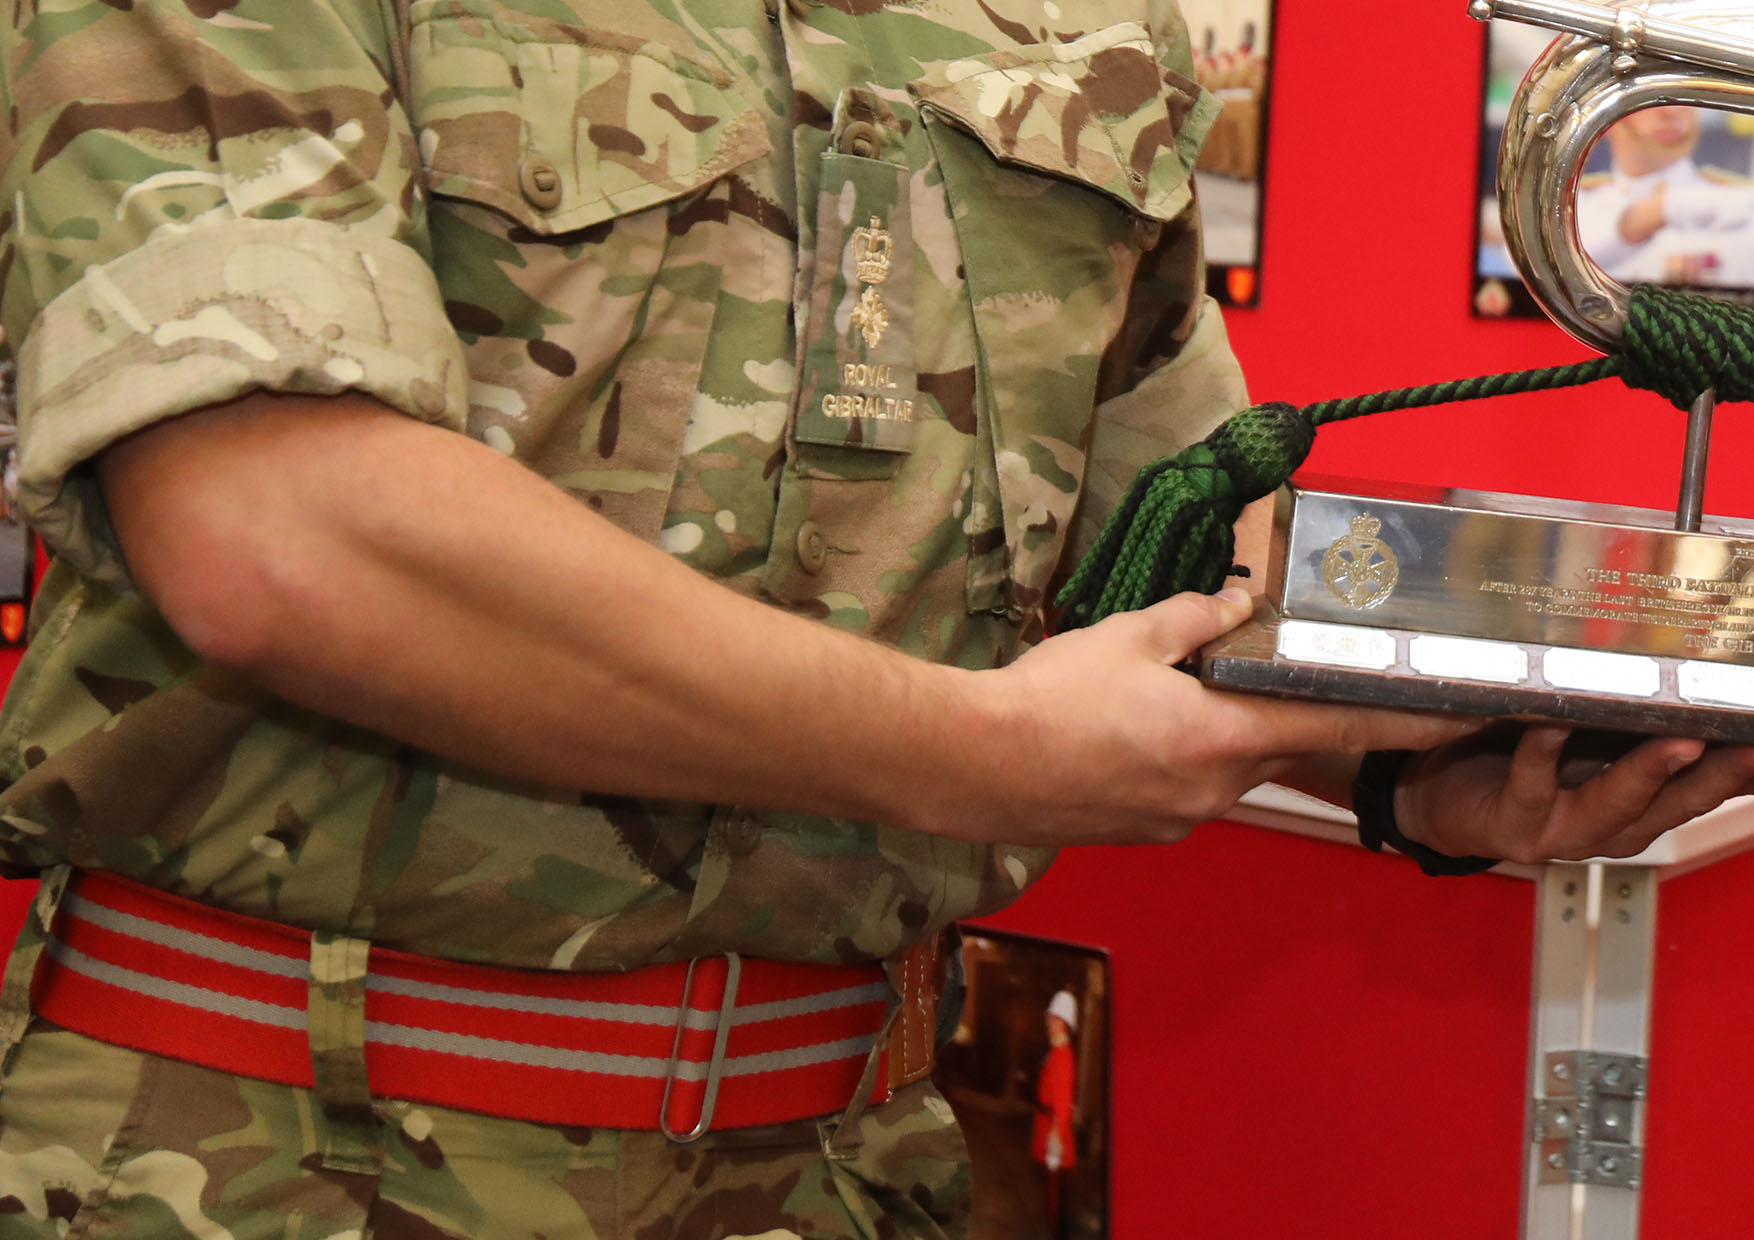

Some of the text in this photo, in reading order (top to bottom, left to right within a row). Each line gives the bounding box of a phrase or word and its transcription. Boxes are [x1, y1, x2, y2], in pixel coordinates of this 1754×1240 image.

[844, 363, 897, 389] ROYAL
[822, 393, 913, 423] GIBRALTAR
[1586, 568, 1621, 585] THE
[1627, 572, 1681, 590] THIRD
[1480, 581, 1517, 594] AFTER
[1539, 587, 1576, 600] YEARS
[1577, 591, 1601, 603] THE
[1604, 593, 1633, 606] LAST
[1526, 601, 1542, 612] TO
[1546, 603, 1639, 623] COMMEMORATE
[1684, 634, 1719, 650] THE
